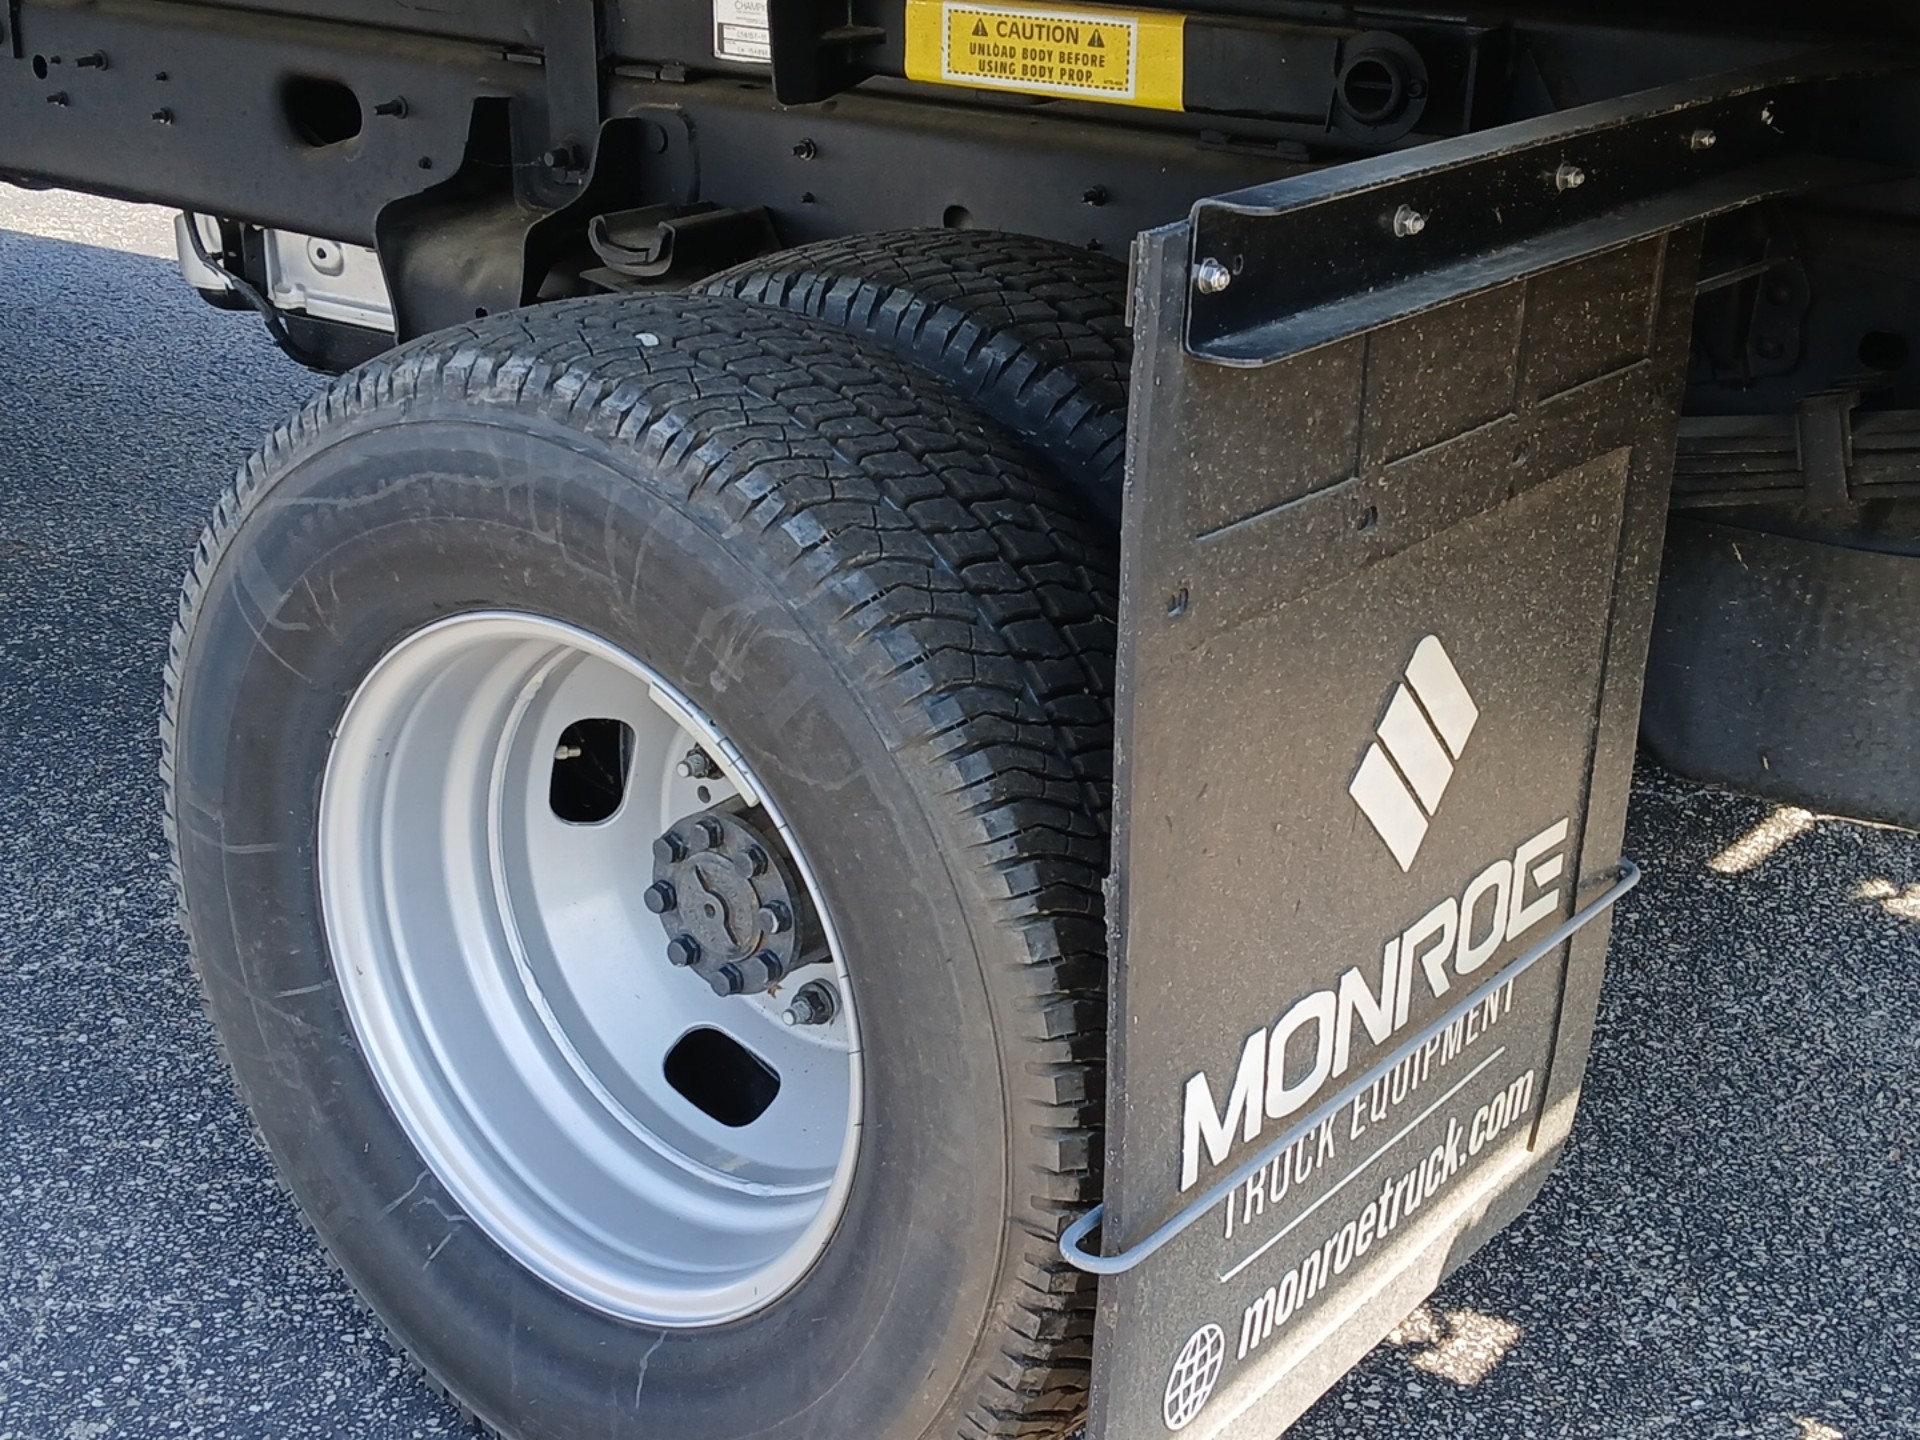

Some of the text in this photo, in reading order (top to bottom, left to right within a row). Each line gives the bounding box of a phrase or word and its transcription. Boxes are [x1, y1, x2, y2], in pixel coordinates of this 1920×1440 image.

[969, 42, 1106, 67] UNLOAD BODY BEFORE
[978, 59, 1016, 76] USING
[1021, 64, 1054, 80] BODY
[1059, 68, 1094, 83] PROP.
[996, 21, 1079, 44] CAUTION
[1180, 817, 1569, 1192] MONROE
[1224, 977, 1515, 1240] TRUCK EQUIPMENT
[1236, 1069, 1535, 1360] monroetruck.com
